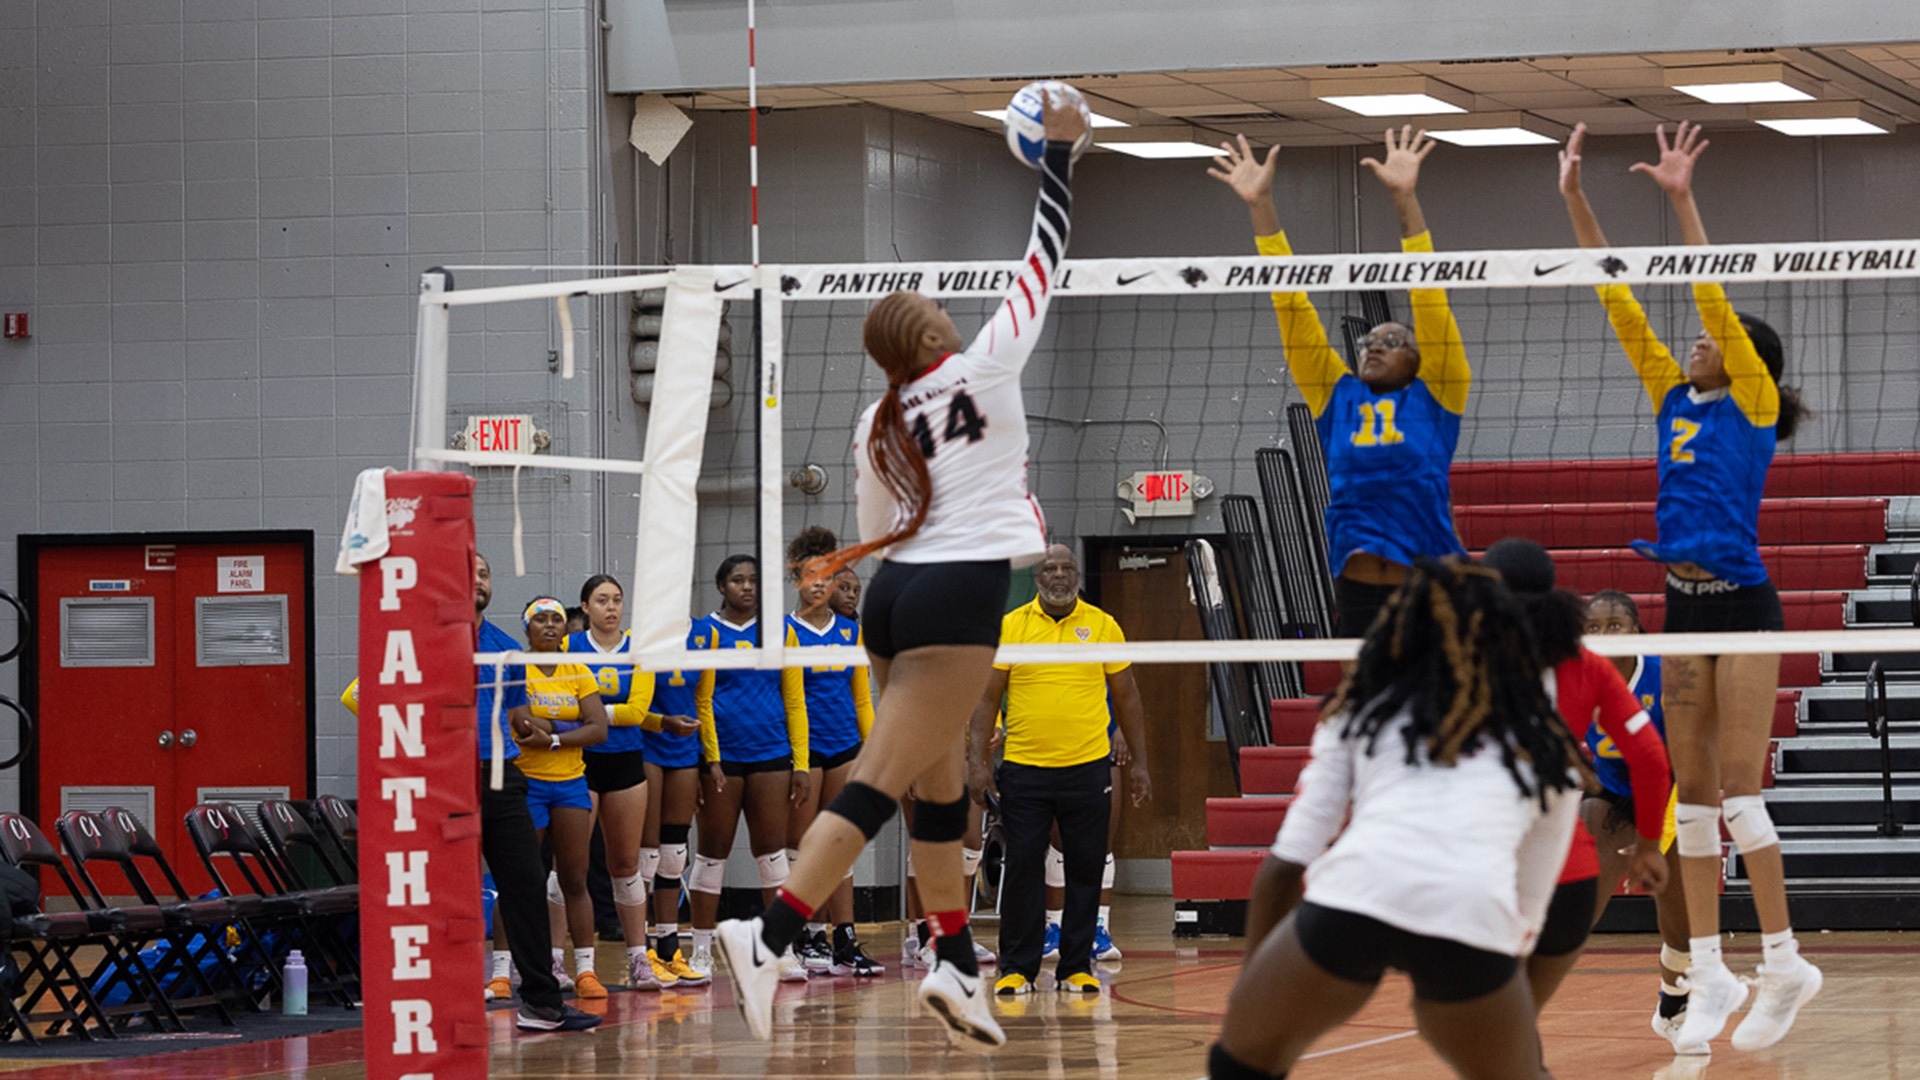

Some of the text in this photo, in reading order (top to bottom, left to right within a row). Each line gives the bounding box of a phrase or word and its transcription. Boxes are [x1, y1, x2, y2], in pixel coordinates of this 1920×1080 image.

[818, 269, 1072, 294] PANTHER VOLLEYLL
[1225, 260, 1487, 286] PANTHER VOLLEYBALL
[1646, 249, 1916, 276] PANTHER VOLLEYBALL
[480, 419, 521, 452] EXIT
[912, 388, 988, 458] 14
[1350, 399, 1404, 446] 11
[1670, 416, 1702, 464] 2
[378, 556, 439, 1080] PANTHER
